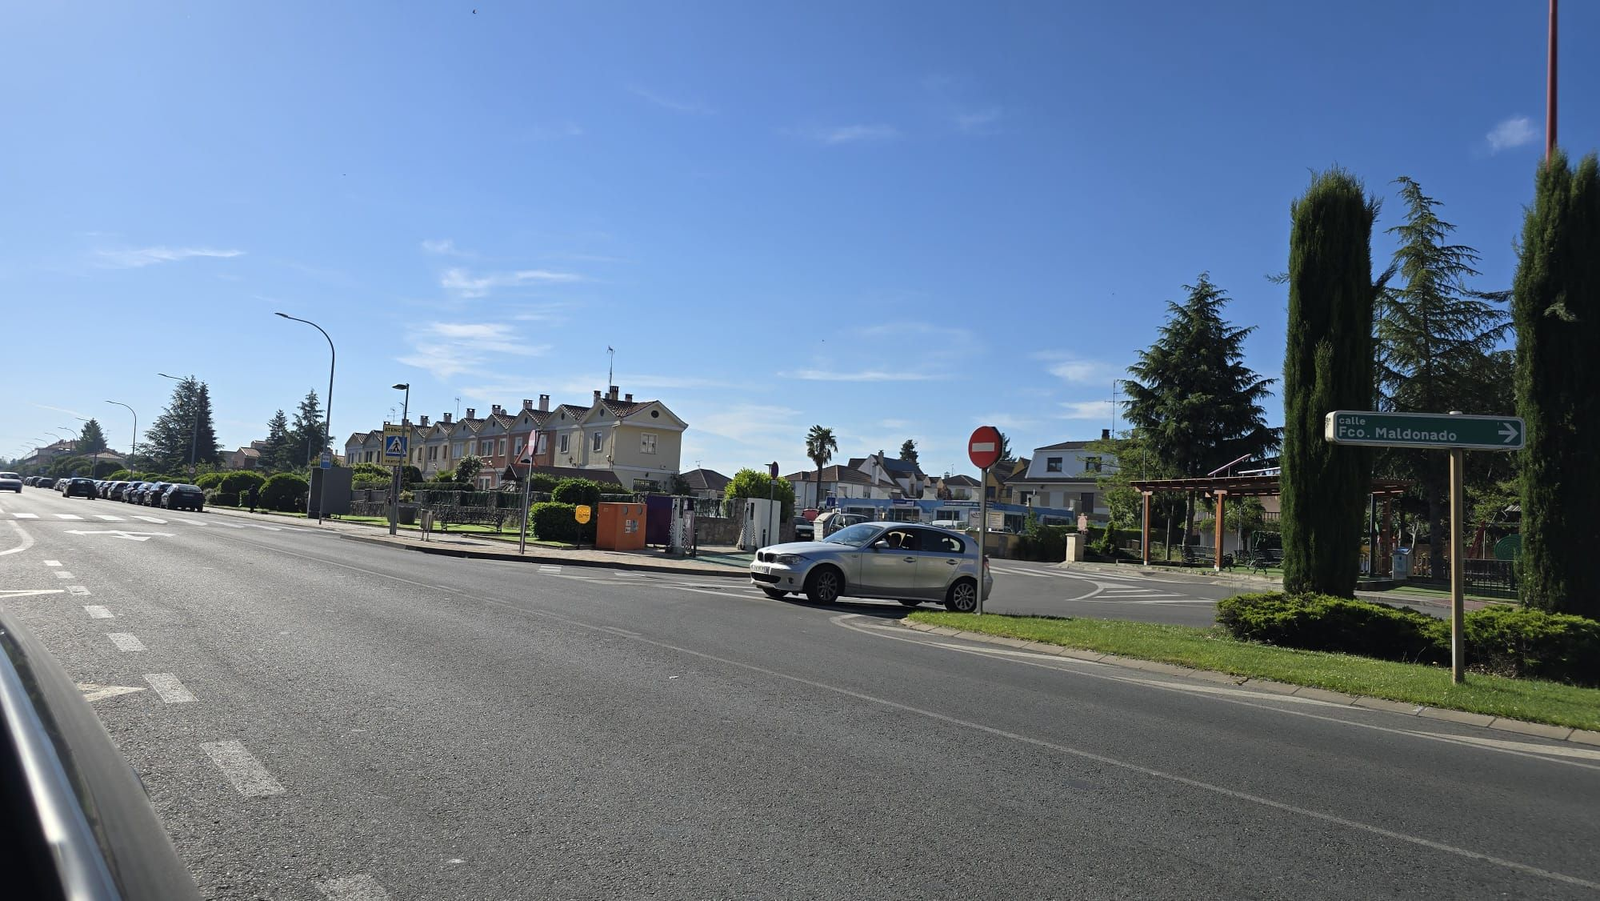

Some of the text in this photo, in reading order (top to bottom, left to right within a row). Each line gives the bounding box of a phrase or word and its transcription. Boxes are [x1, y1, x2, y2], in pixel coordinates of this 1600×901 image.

[1338, 417, 1366, 426] calle
[1338, 426, 1457, 441] Fco. Maldonado
